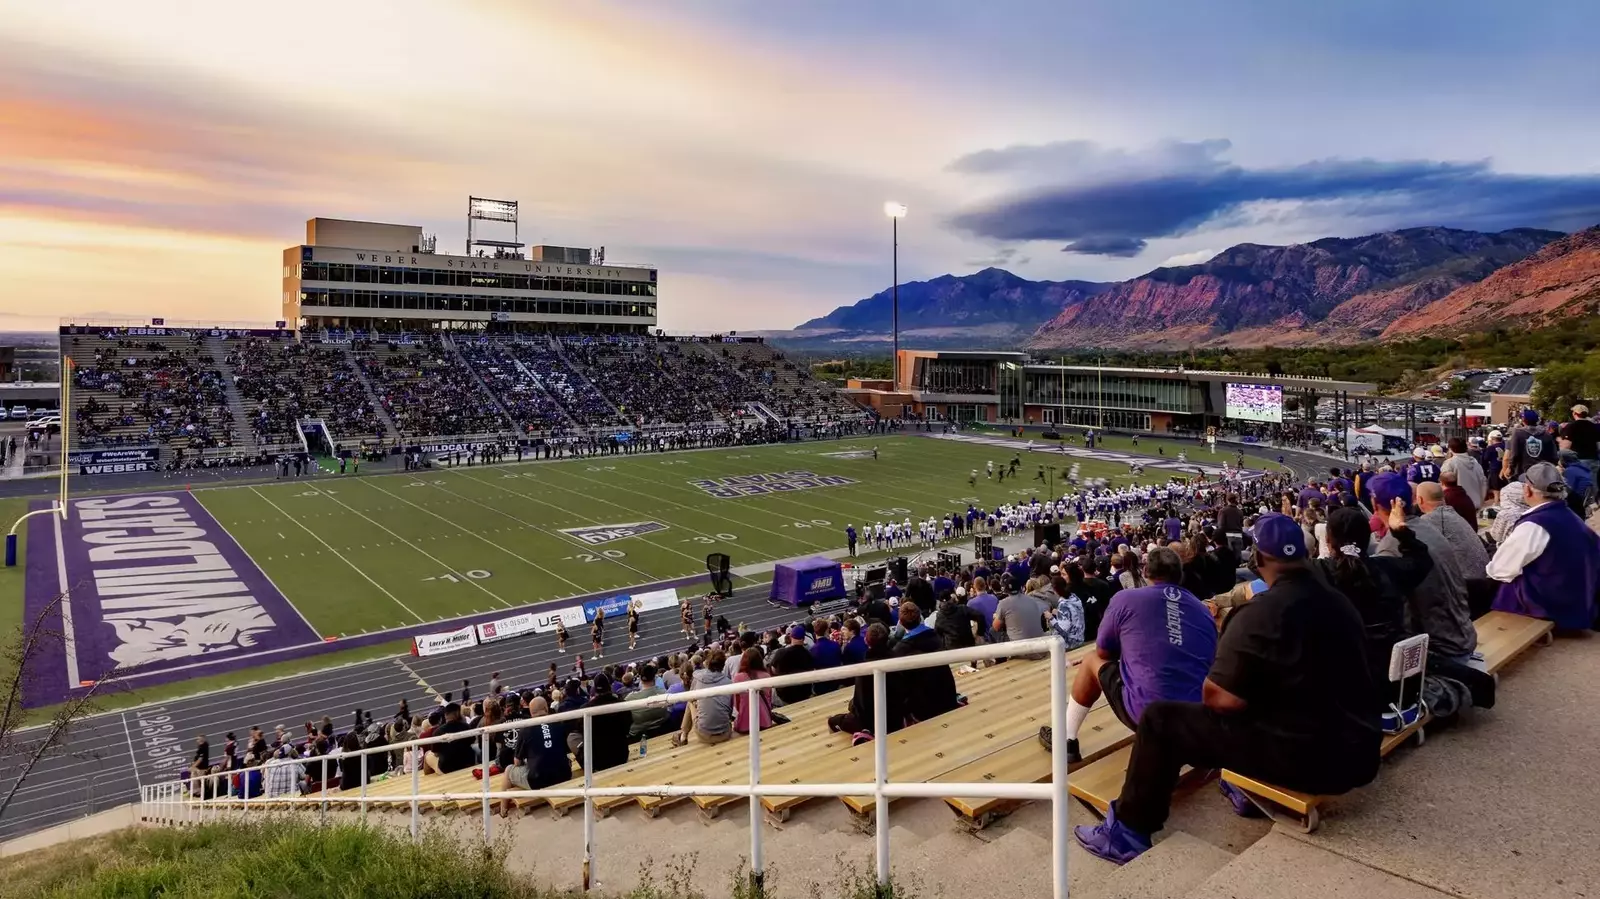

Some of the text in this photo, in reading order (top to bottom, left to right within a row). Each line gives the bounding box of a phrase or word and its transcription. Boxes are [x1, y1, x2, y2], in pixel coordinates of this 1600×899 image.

[356, 253, 623, 278] WEBER STATE UNIVERSITY
[421, 442, 470, 453] WILDCAT
[85, 463, 147, 474] WEBER
[1420, 464, 1434, 478] 17
[687, 469, 819, 489] STATE
[701, 475, 862, 499] WEBER
[874, 507, 912, 516] 50
[793, 519, 833, 530] 40
[578, 528, 635, 543] SKY
[696, 533, 739, 544] 30
[75, 496, 277, 627] WILDCATS
[576, 549, 628, 563] 20
[439, 569, 492, 584] 10
[811, 576, 833, 590] JMU
[1166, 600, 1184, 646] WILDCATS
[452, 633, 470, 642] Miller
[484, 627, 496, 635] LOC
